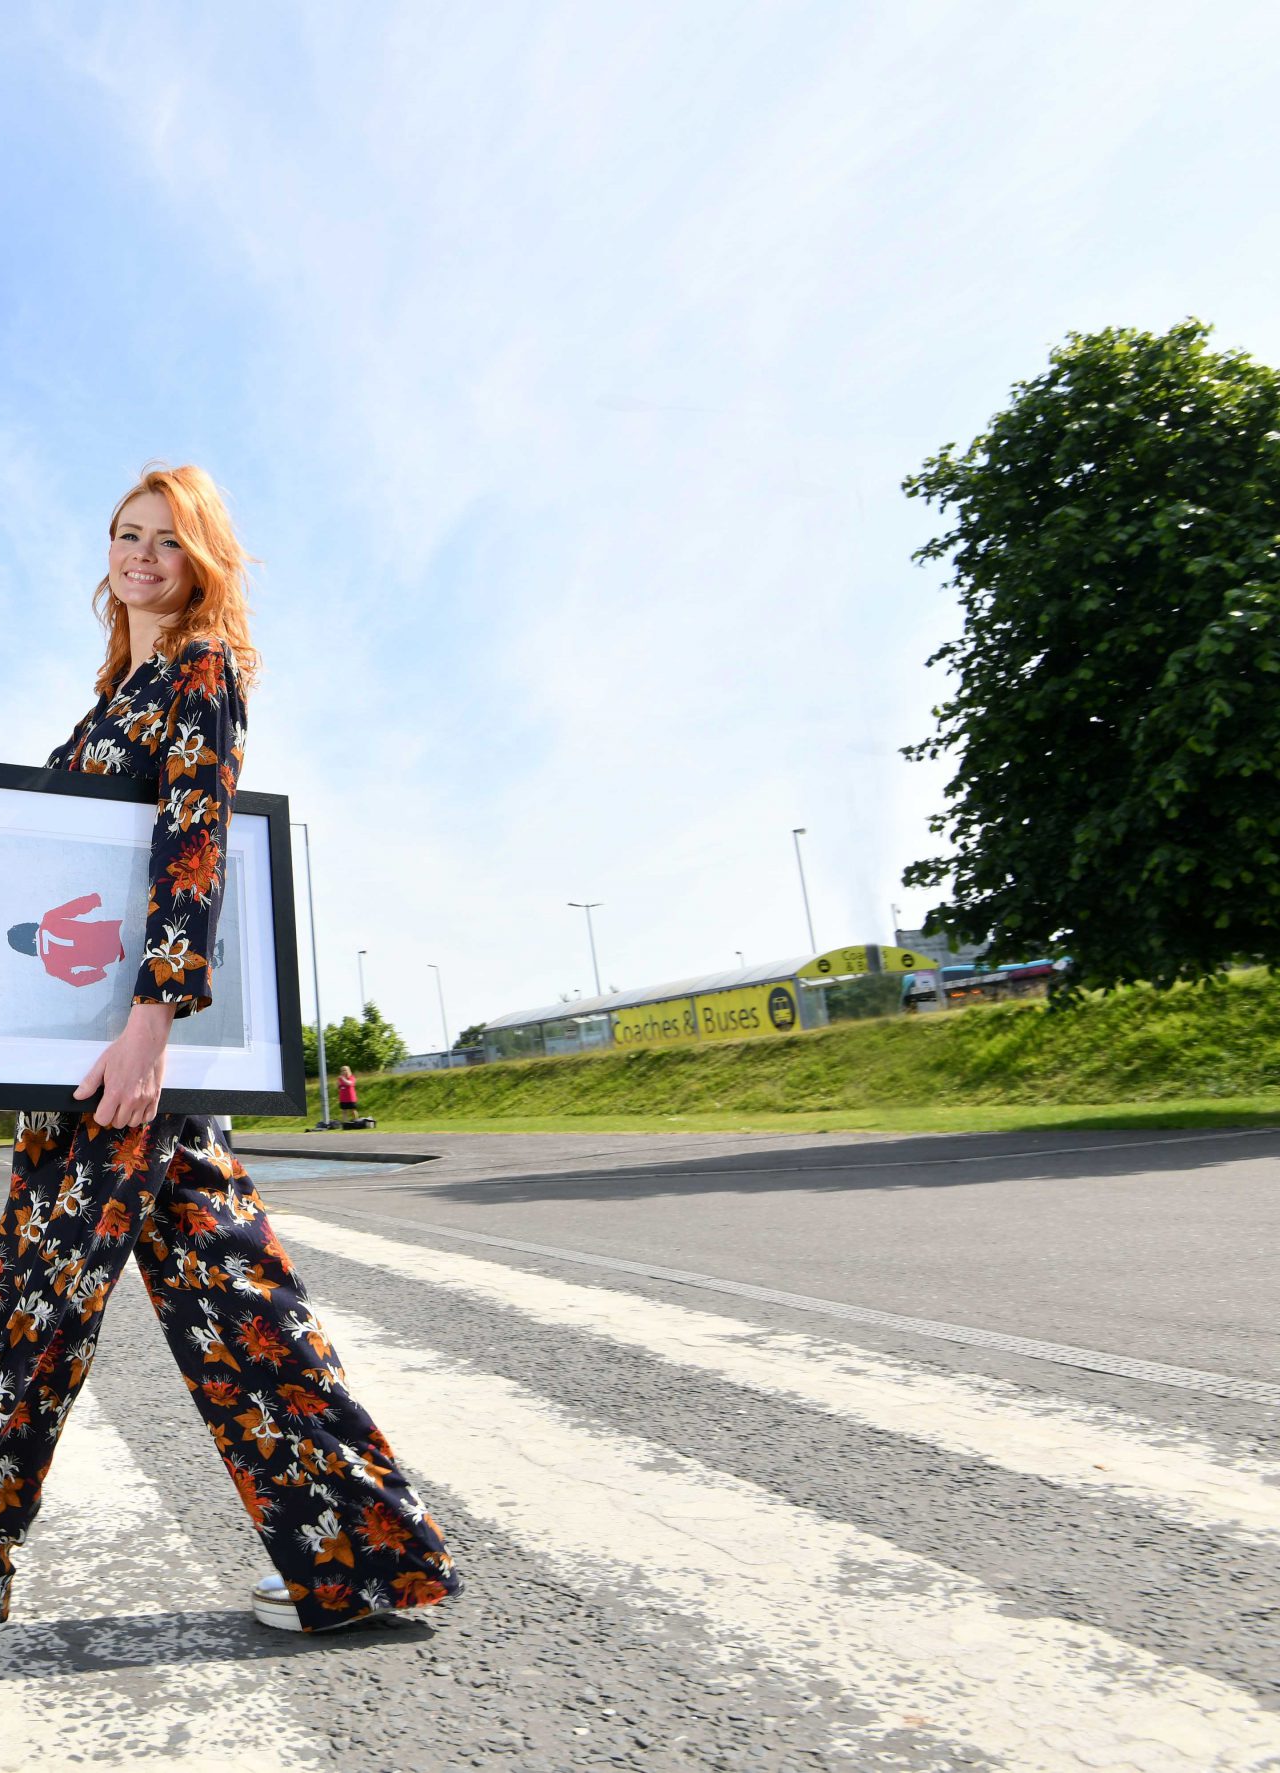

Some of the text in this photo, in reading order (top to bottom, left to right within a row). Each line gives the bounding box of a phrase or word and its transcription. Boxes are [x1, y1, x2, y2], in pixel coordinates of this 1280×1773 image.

[41, 929, 74, 955] 7
[612, 1006, 761, 1045] Coaches & Buses
